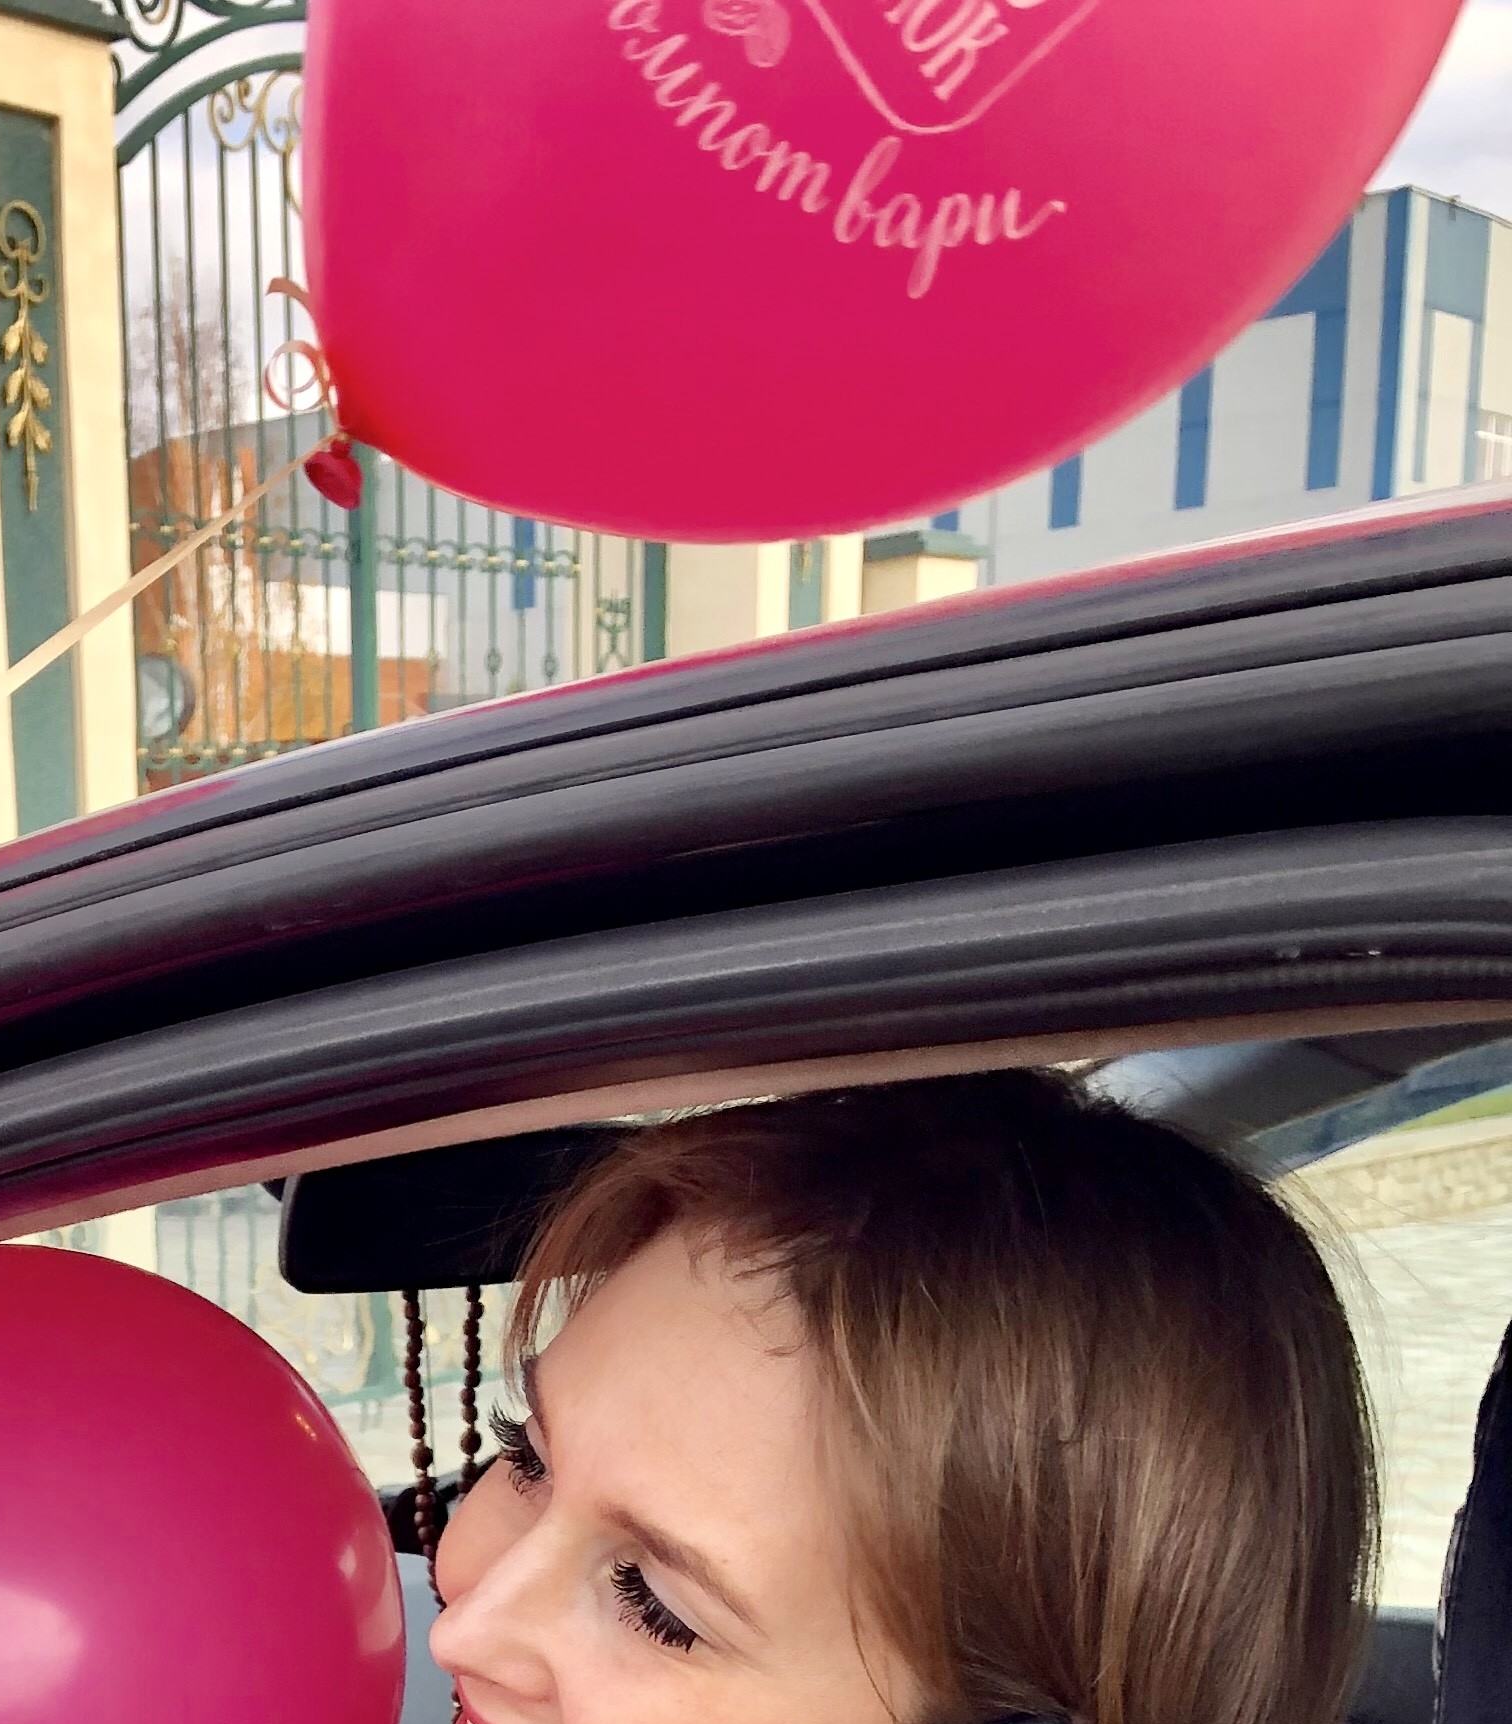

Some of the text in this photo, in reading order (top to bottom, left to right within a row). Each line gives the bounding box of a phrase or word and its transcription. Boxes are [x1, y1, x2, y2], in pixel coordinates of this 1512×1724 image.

[608, 0, 1068, 299] омпот вари
[883, 0, 1010, 101] ОК
